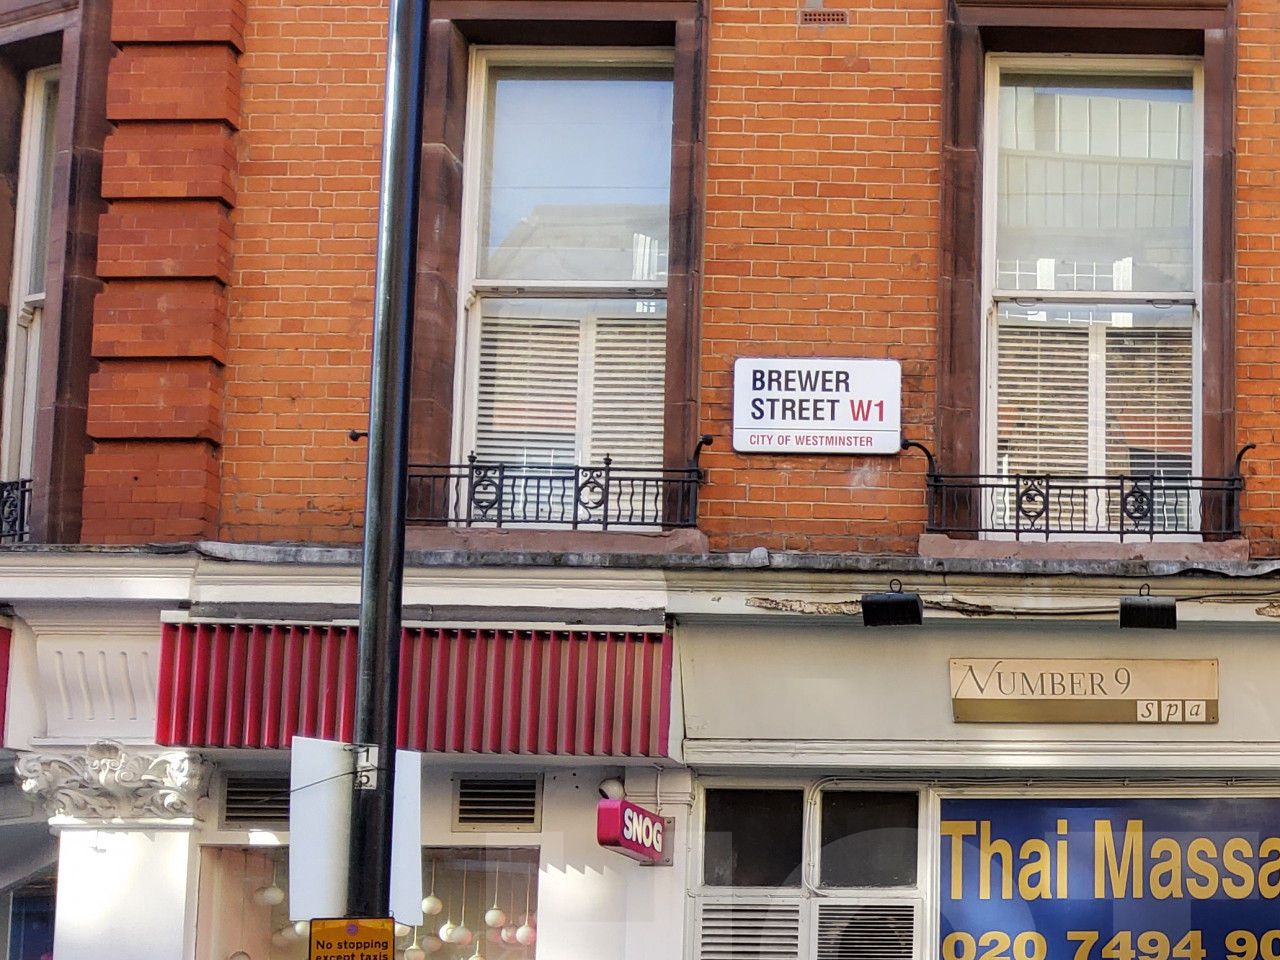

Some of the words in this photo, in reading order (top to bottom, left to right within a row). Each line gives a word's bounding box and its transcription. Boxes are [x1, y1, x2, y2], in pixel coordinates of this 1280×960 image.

[752, 369, 850, 393] BREWER
[751, 398, 840, 421] STREET
[850, 399, 884, 422] W1
[749, 434, 773, 446] CITY
[777, 434, 792, 446] OF
[795, 435, 873, 447] WESTMINSTER
[954, 660, 1108, 698] NUMBER
[1114, 667, 1131, 695] 9
[1141, 702, 1202, 722] spa
[623, 808, 663, 853] SNOG
[939, 818, 1068, 900] Thai
[316, 940, 333, 950] No
[337, 939, 389, 951] stopping
